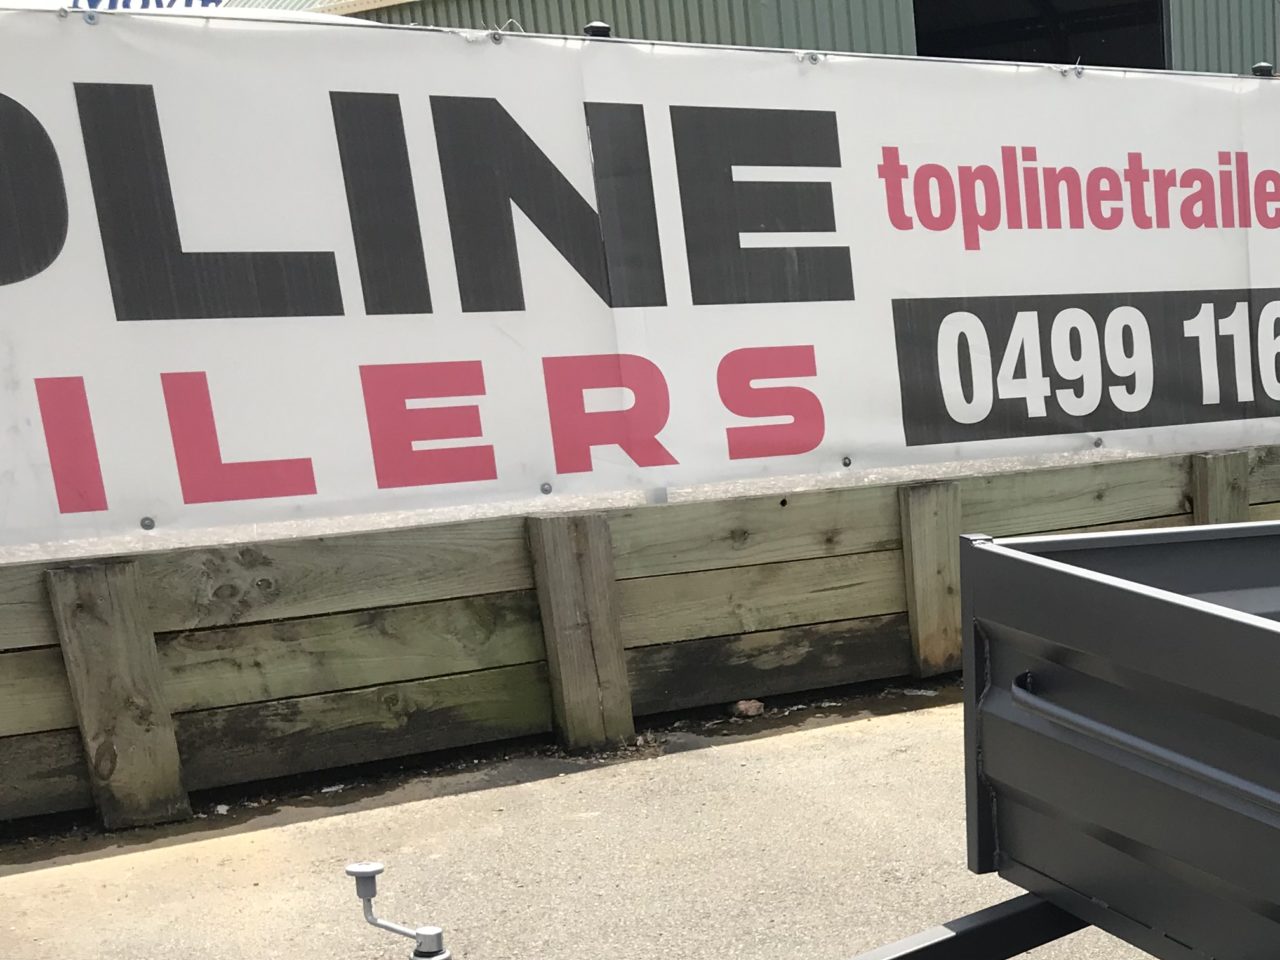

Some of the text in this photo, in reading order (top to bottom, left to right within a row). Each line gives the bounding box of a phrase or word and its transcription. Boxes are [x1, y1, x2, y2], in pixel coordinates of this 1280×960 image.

[0, 82, 856, 321] LINE
[35, 345, 826, 514] ILERS
[936, 305, 1155, 425] 0499
